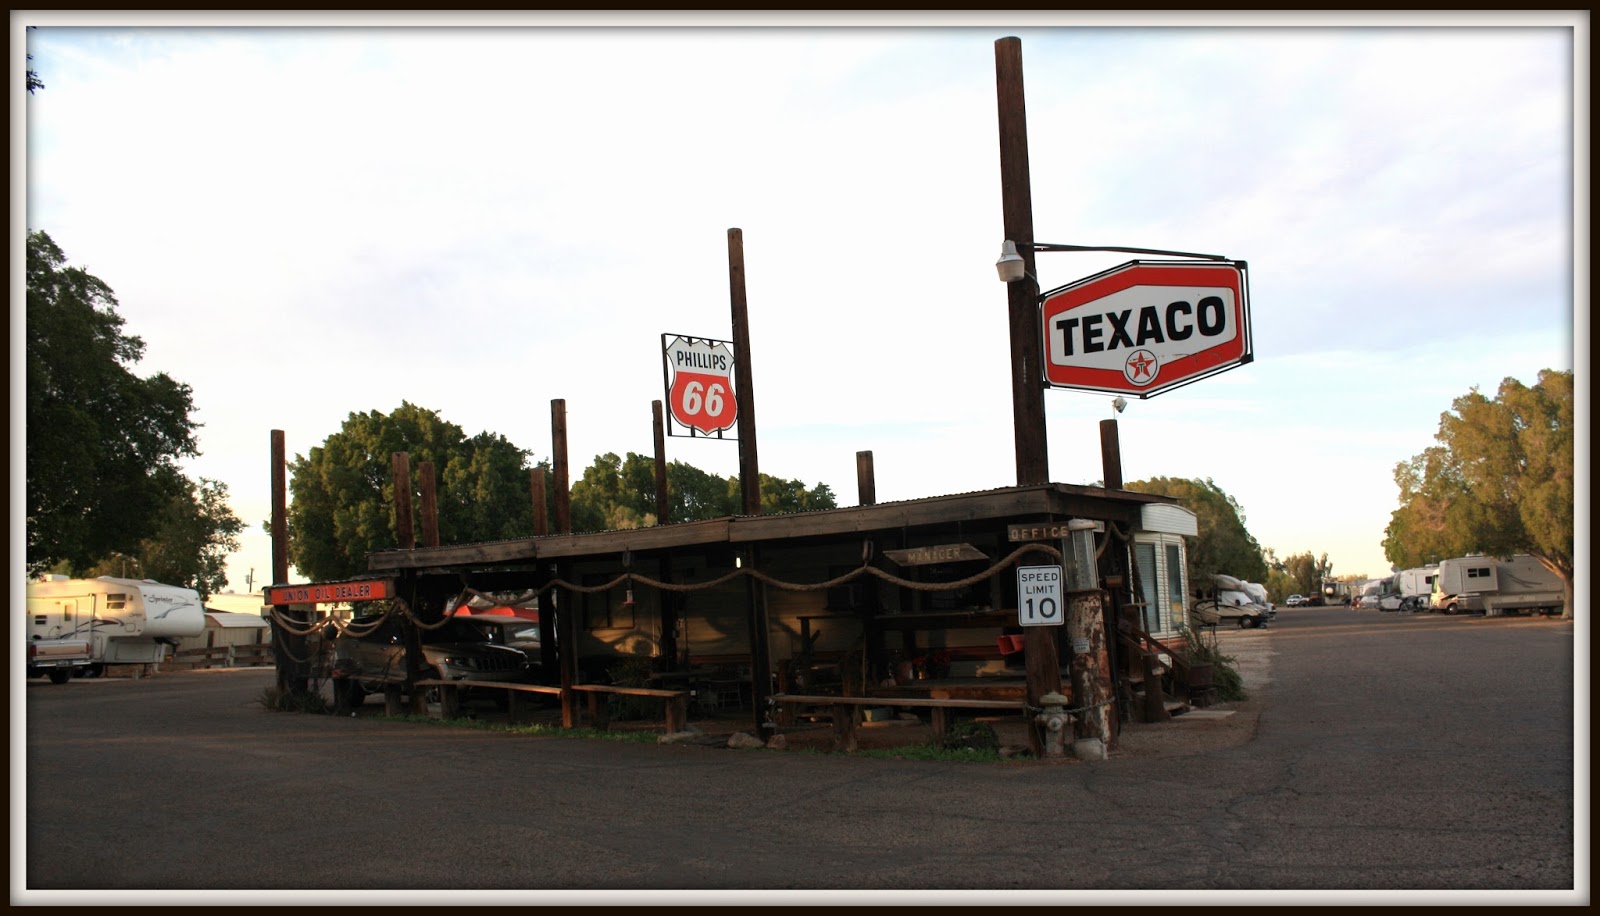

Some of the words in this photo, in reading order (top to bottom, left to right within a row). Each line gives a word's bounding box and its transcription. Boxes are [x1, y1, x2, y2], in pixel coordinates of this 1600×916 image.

[1056, 295, 1226, 357] TEXACO
[676, 350, 727, 371] PHILLIPS
[682, 381, 725, 417] 66
[1011, 526, 1068, 540] OFFICE
[907, 548, 961, 562] MANAGER
[1021, 573, 1058, 582] SPEED
[283, 589, 310, 602] UNION
[315, 587, 331, 600] OIL
[335, 584, 371, 598] DEALER
[1025, 585, 1055, 595] LIMIT
[1025, 597, 1057, 619] 10
